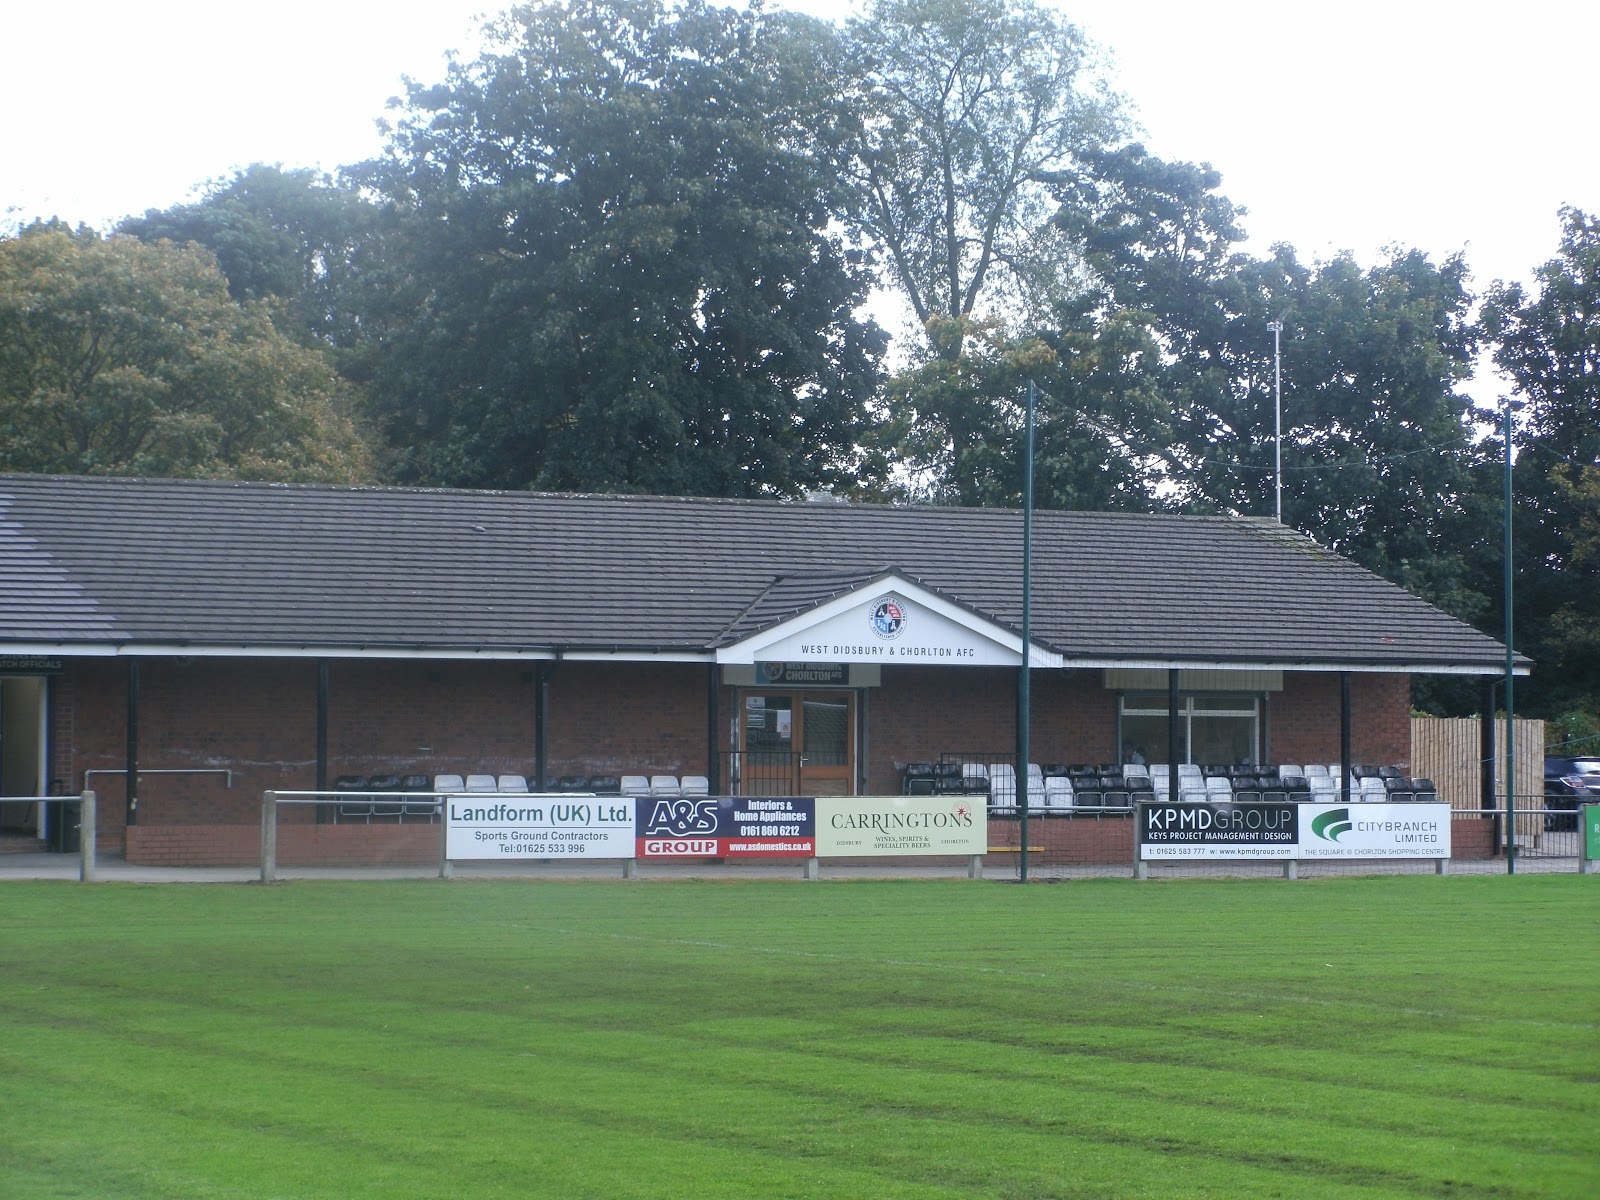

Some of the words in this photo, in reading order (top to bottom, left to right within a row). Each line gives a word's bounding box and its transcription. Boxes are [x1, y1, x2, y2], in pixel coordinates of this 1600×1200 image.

[801, 645, 828, 654] WEST
[833, 646, 884, 655] DIDSBURY
[889, 647, 895, 656] &
[900, 646, 951, 656] CHORLTON
[956, 648, 974, 657] AFC
[786, 662, 804, 670] WEST
[806, 662, 838, 670] DIDSBURY
[786, 670, 830, 680] CHORLTON
[748, 799, 785, 810] Interiors
[786, 801, 793, 810] &
[451, 804, 543, 821] Landform
[550, 804, 591, 826] (UK)
[598, 805, 632, 822] Ltd.
[645, 799, 718, 836] A&S
[734, 811, 758, 822] Home
[760, 811, 807, 822] Appliances
[831, 812, 973, 834] CARRINGTONS
[1357, 821, 1437, 832] CITYBRANCH
[740, 825, 760, 836] 0161
[761, 825, 778, 836] 860
[779, 825, 800, 836] 6212
[1148, 832, 1168, 840] KEYS
[1170, 832, 1202, 840] PROJECT
[1205, 832, 1259, 840] MANAGEMENT
[1264, 832, 1292, 840] DESIGN
[475, 831, 508, 842] Sports
[511, 831, 548, 840] Ground
[551, 831, 608, 841] Contractors
[1395, 834, 1437, 842] LIMITED
[499, 844, 545, 853] Tel:01625
[548, 844, 565, 853] 533
[568, 844, 585, 853] 996
[647, 842, 715, 853] GROUP
[729, 842, 812, 851] www.asdomestics.co.uk
[1219, 848, 1291, 856] www.kpmdgroup.com
